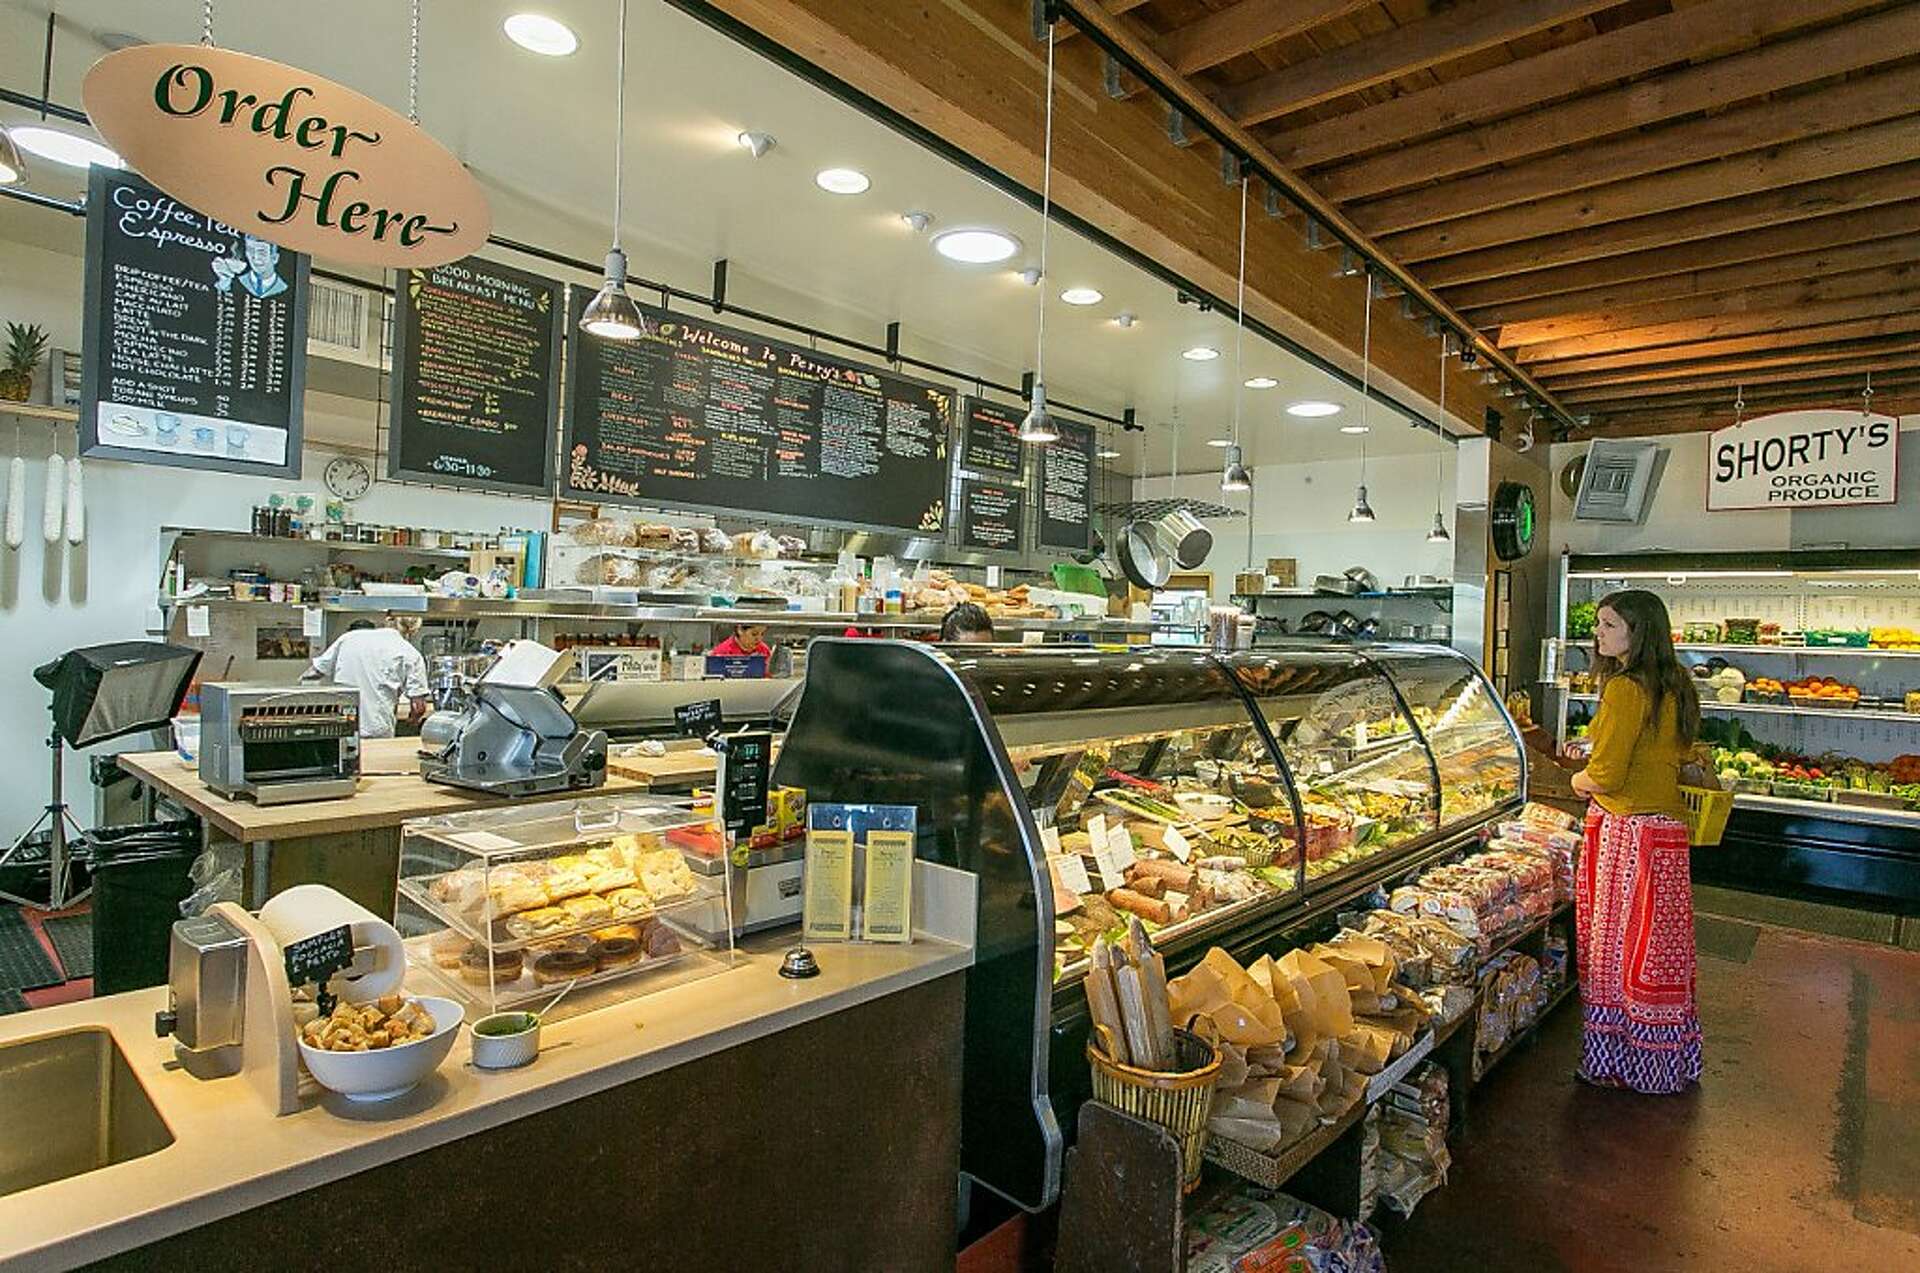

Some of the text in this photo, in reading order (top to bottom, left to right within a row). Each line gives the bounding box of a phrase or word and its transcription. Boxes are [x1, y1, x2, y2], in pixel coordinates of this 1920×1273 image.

[153, 64, 381, 158] Order
[257, 165, 459, 247] Here
[119, 211, 226, 254] Espresso
[432, 273, 497, 299] BREAKFAST
[475, 273, 531, 297] MORNING
[682, 326, 749, 355] Welcome
[790, 353, 840, 380] Perry's
[1715, 423, 1889, 483] SHORTY'S
[1768, 485, 1879, 502] PRODUCE
[1771, 470, 1877, 488] ORGANIC
